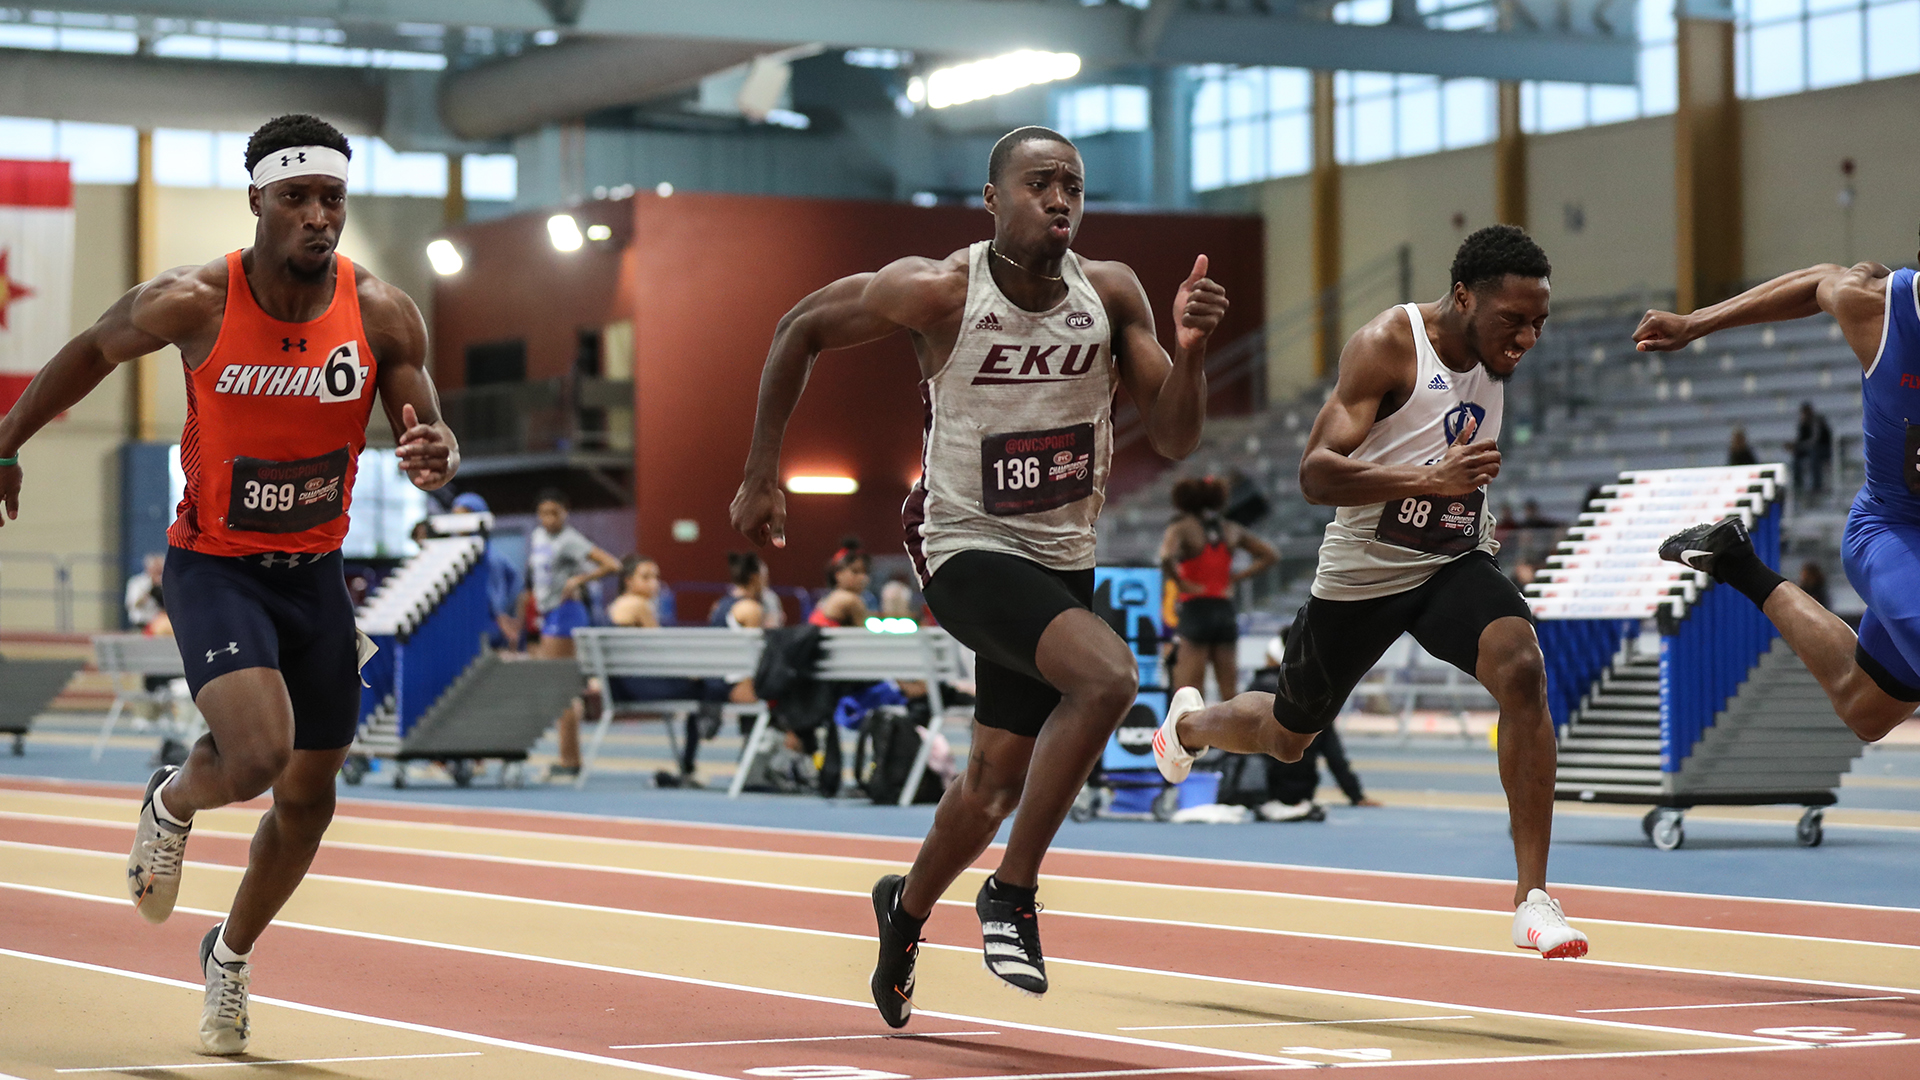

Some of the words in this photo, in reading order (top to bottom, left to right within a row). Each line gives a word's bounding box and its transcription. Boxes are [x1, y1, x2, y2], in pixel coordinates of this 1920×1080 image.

[975, 321, 1003, 331] adidas
[325, 346, 355, 397] 6
[978, 343, 1100, 375] EKU
[215, 364, 370, 397] SKYHAWS
[1005, 433, 1076, 455] @OVCSPORTS
[993, 456, 1040, 490] 136
[243, 480, 295, 512] 369
[1397, 497, 1432, 528] 98
